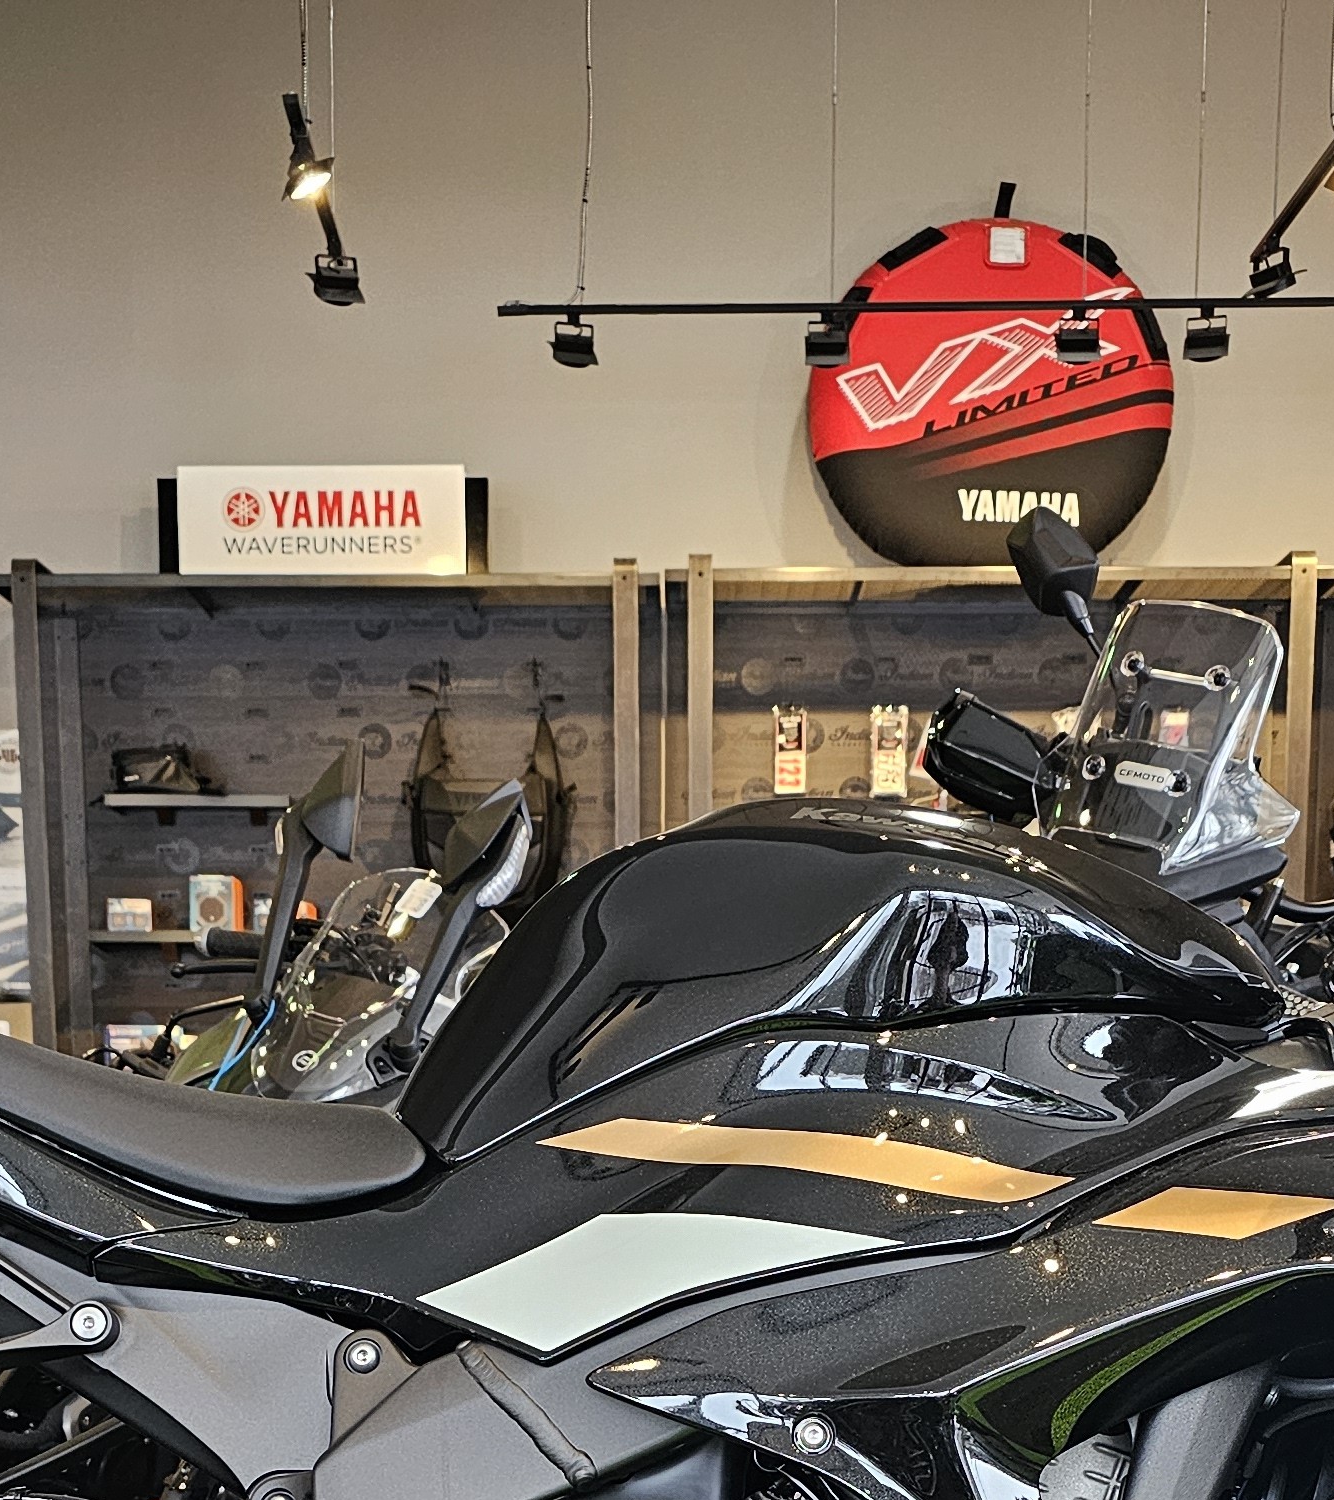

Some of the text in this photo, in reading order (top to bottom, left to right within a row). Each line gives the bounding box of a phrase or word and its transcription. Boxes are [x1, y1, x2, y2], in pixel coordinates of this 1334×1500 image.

[923, 354, 1139, 438] LIMITED
[268, 490, 422, 528] YAMAHA
[957, 488, 1080, 527] YAMAHA
[222, 535, 413, 555] WAVERUNNERS
[778, 757, 802, 787] 123
[1119, 768, 1165, 784] CFMOTO
